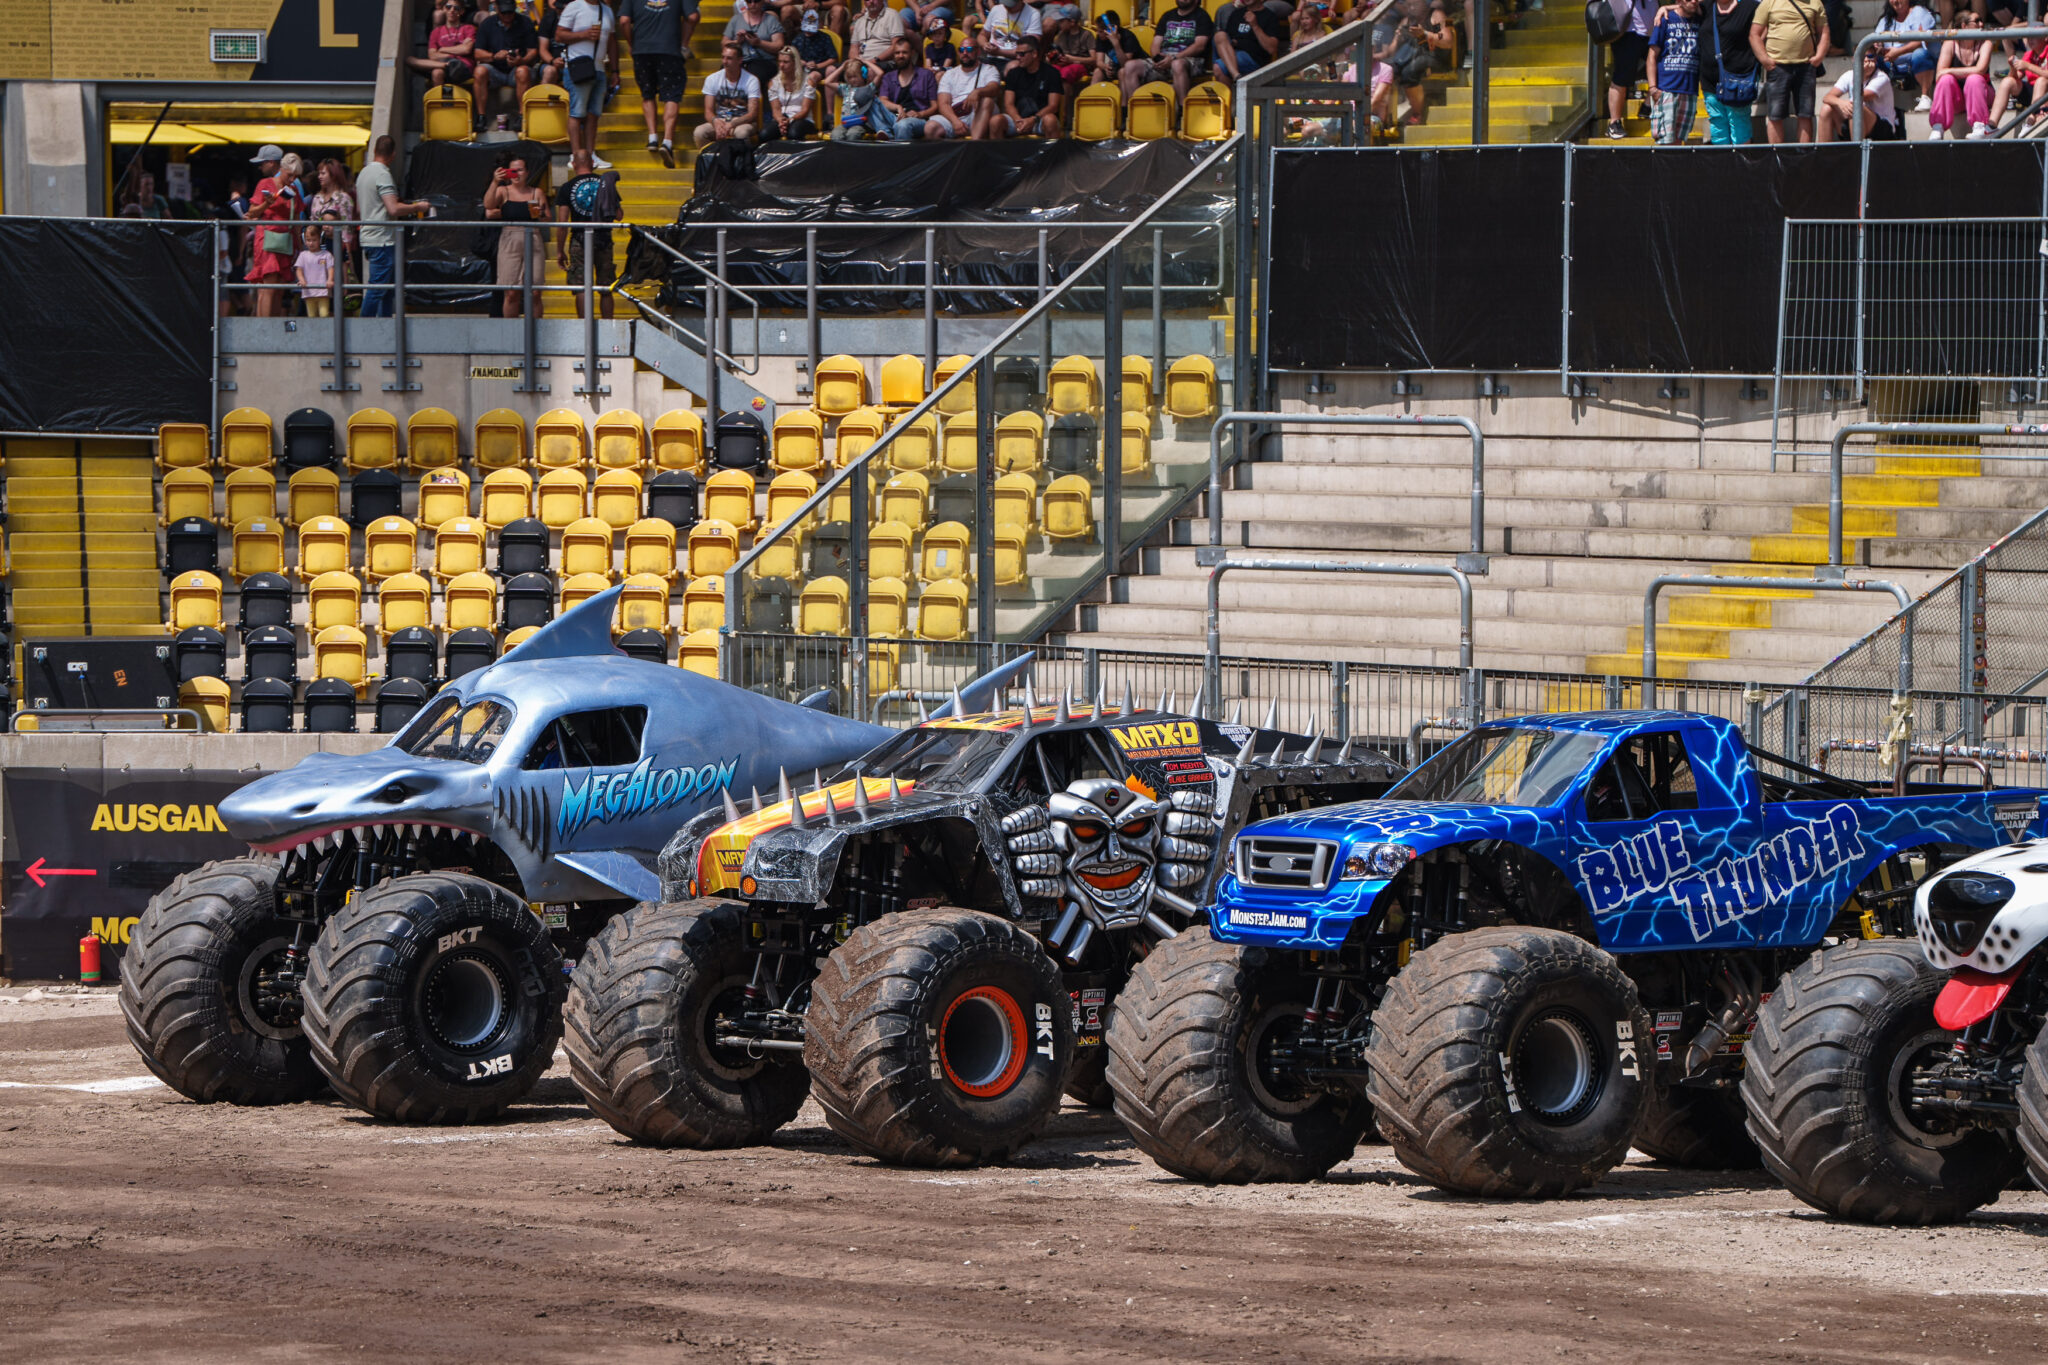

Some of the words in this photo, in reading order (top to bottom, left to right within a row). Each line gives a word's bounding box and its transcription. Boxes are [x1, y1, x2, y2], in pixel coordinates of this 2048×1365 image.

[1109, 721, 1200, 750] MAX-D
[1126, 748, 1160, 759] MAXIMUM
[1161, 746, 1202, 757] DESTRUCTION
[1165, 763, 1179, 771] TOM
[557, 753, 741, 844] MEGALODON
[1994, 810, 2040, 821] MONSTER
[2005, 820, 2027, 829] JAM
[1578, 820, 1692, 915] BLUE
[1668, 803, 1866, 942] THUNDER
[438, 926, 483, 953] BKT
[1035, 1002, 1054, 1061] BKT
[1615, 1020, 1641, 1081] BKT
[467, 1054, 513, 1081] BKT
[1499, 1052, 1522, 1113] BKT
